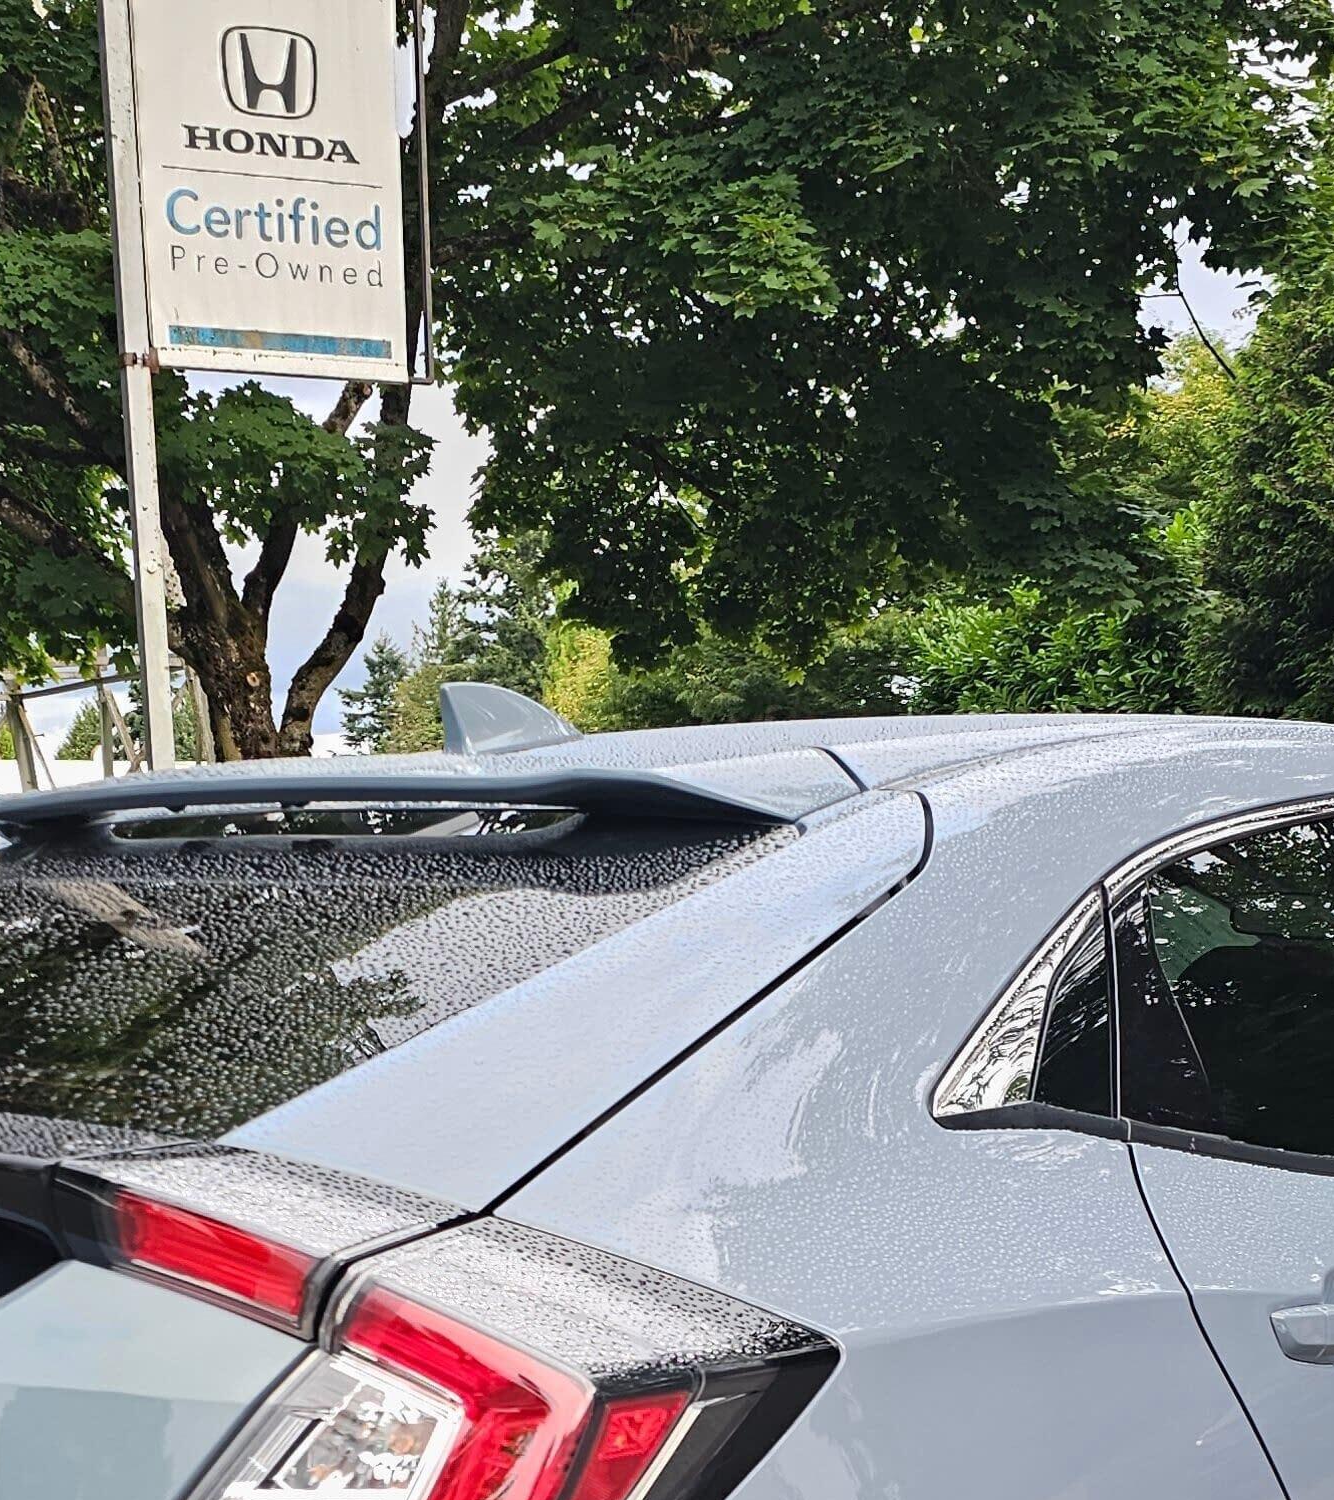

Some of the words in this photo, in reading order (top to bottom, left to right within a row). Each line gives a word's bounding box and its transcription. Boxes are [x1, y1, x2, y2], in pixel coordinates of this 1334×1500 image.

[182, 123, 360, 165] HONDA
[166, 188, 382, 252] Certified
[169, 244, 384, 288] Pre-Owned
